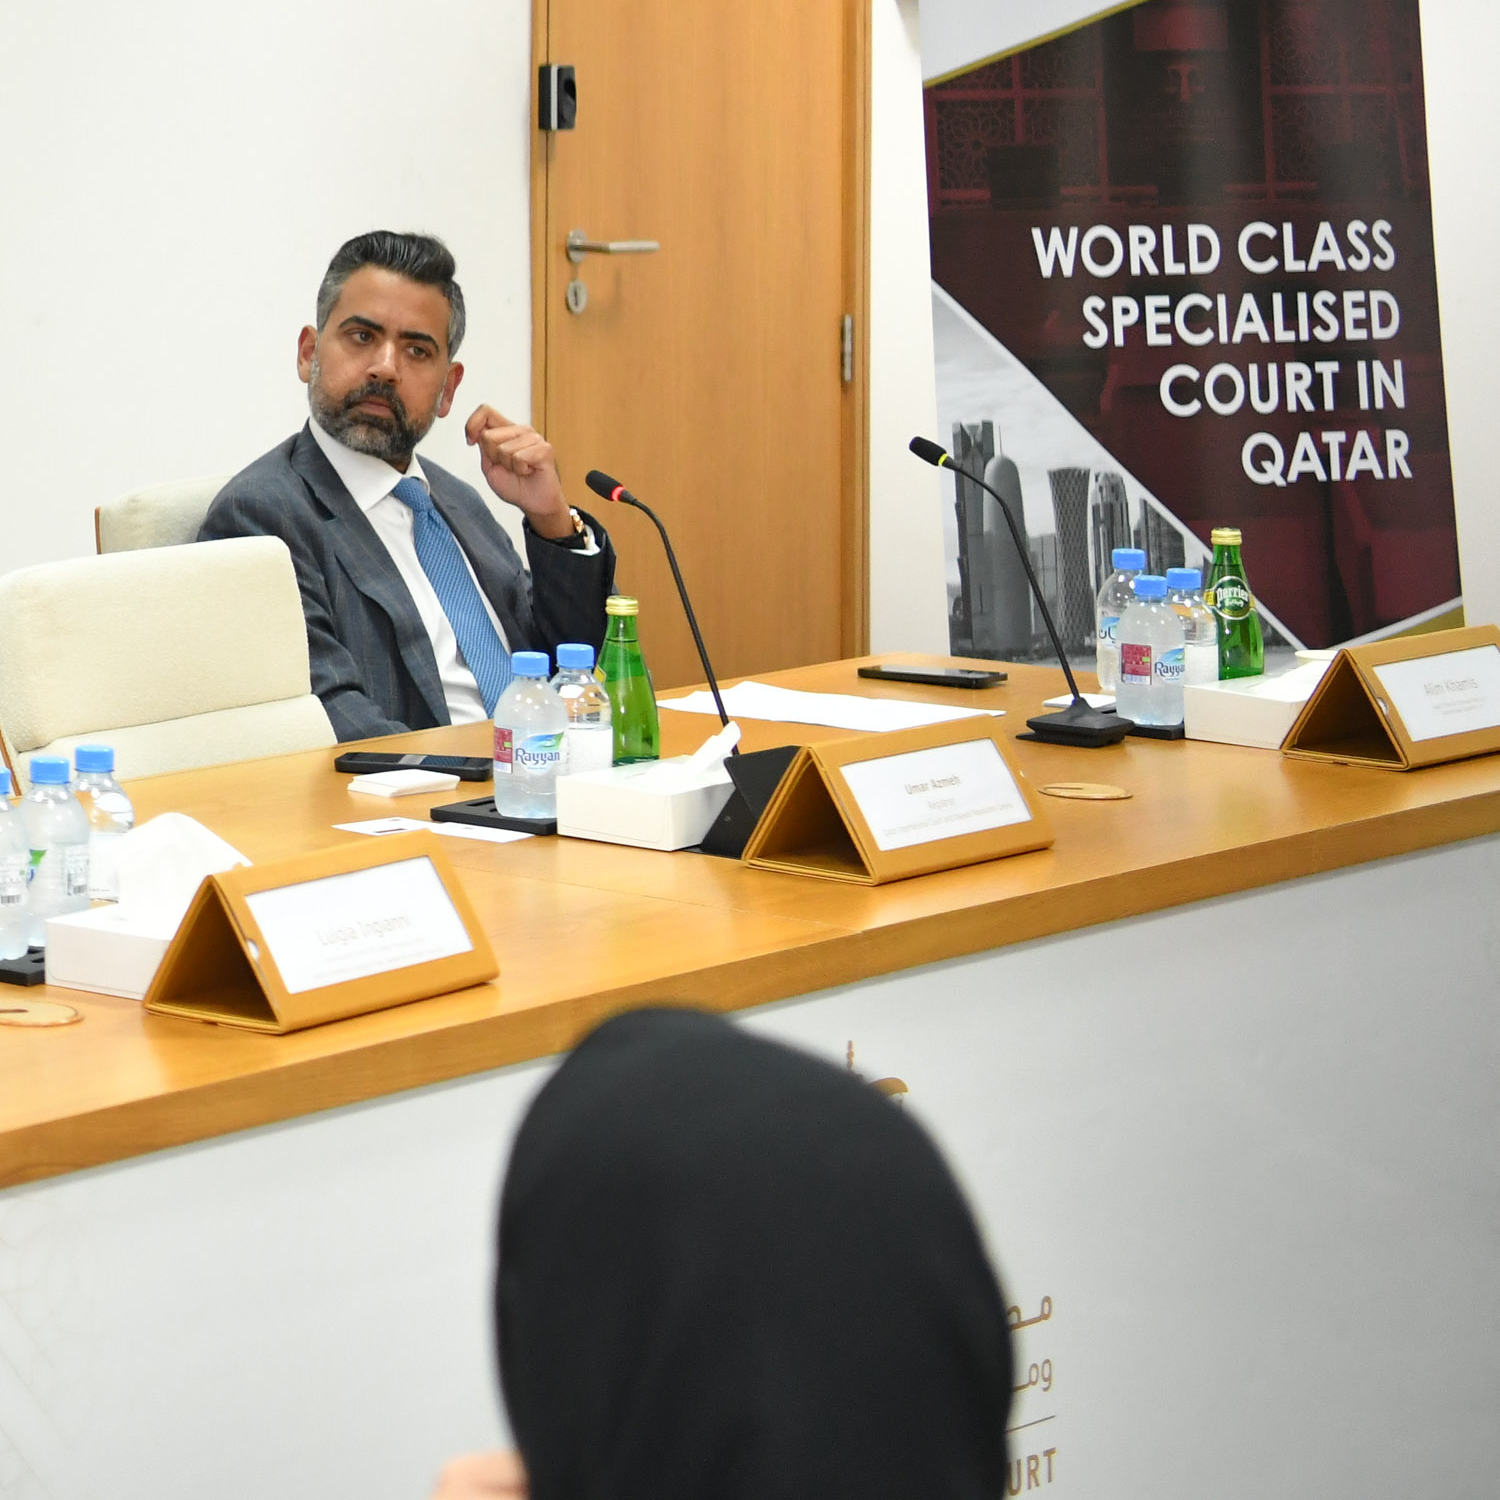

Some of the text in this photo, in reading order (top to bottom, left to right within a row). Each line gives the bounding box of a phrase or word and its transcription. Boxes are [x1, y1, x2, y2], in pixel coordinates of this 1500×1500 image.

[1032, 219, 1396, 278] WORLD CLASS
[1081, 290, 1400, 349] SPECIALISED
[1159, 359, 1405, 418] COURT IN
[1241, 429, 1412, 487] QATAR
[1155, 662, 1184, 677] Rayya
[515, 748, 560, 765] Rayyan
[1008, 1447, 1056, 1496] URT
